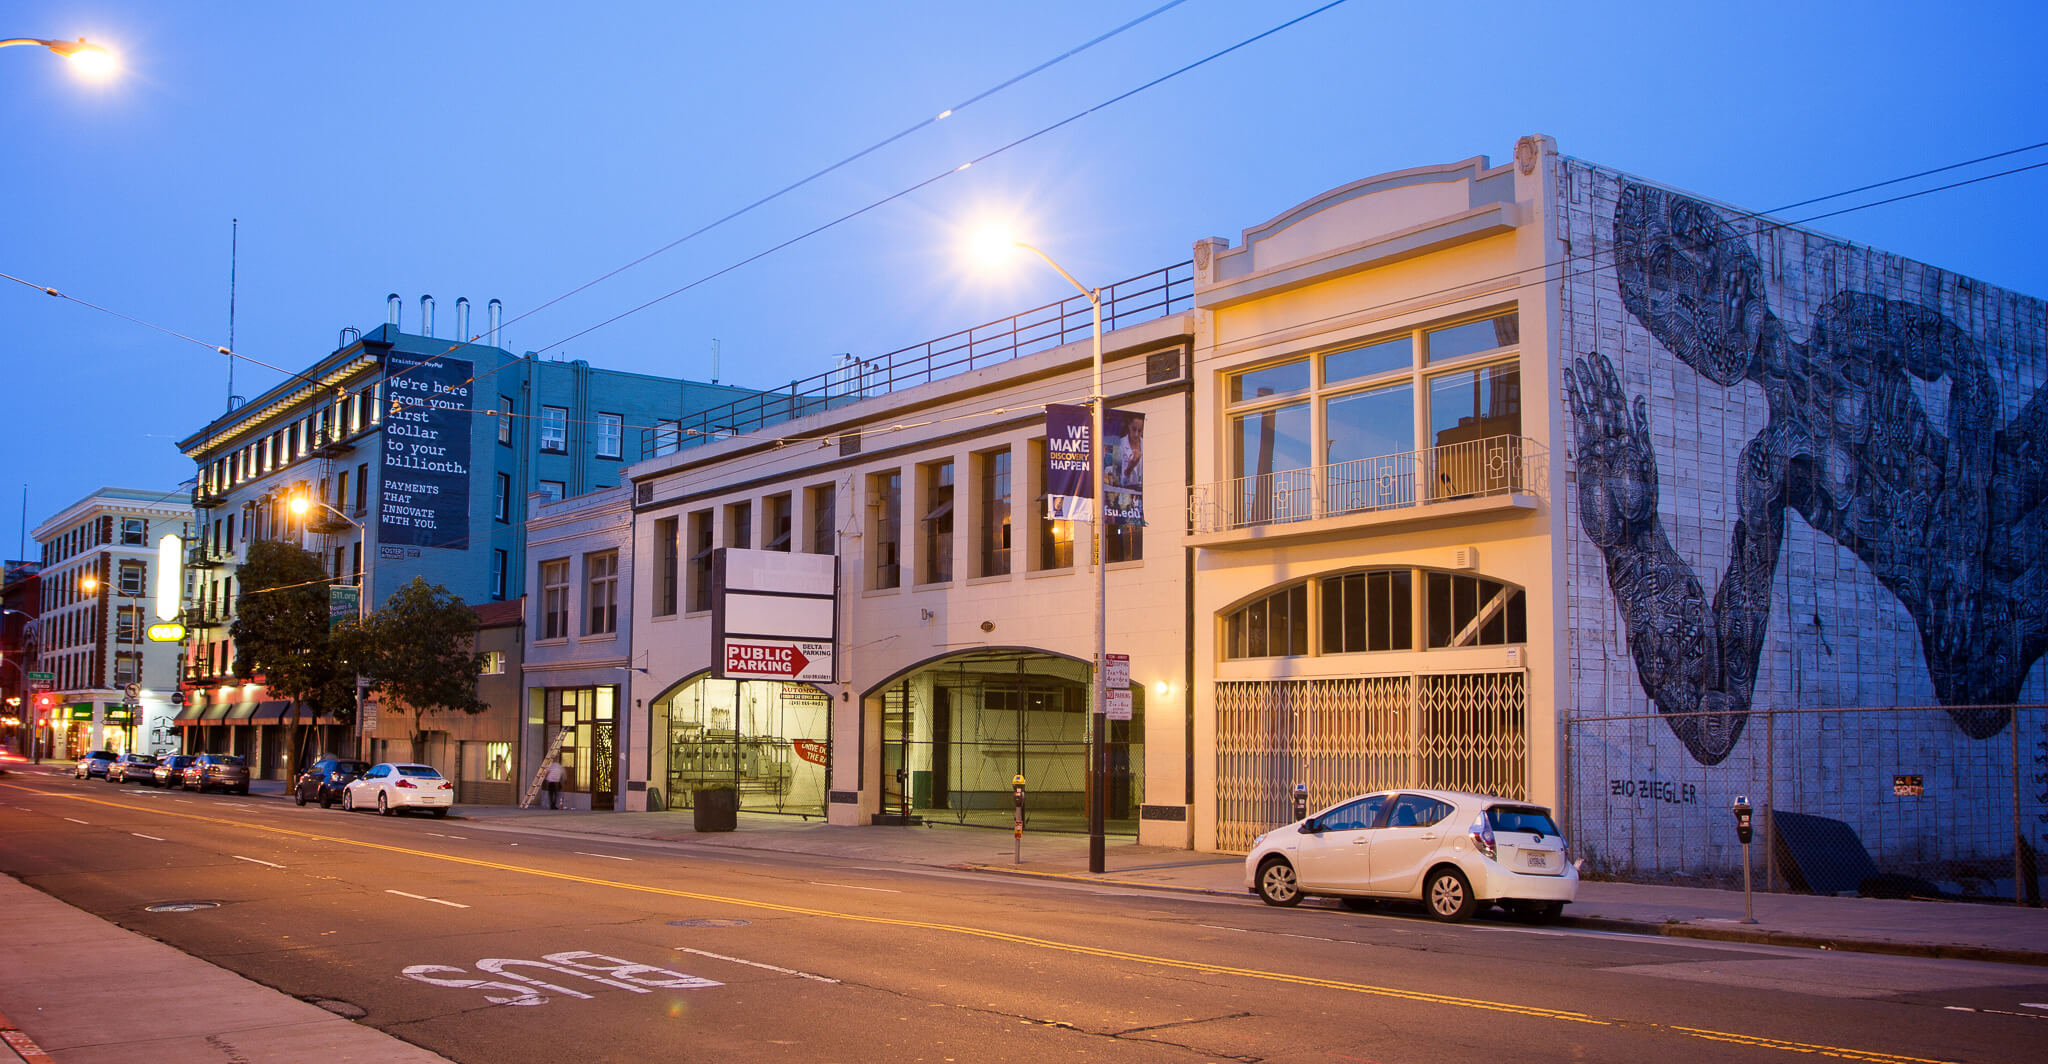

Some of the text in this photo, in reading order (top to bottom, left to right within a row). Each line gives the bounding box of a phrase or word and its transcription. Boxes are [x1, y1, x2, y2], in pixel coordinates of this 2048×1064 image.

[390, 376, 468, 397] We're here
[390, 391, 465, 411] from your
[388, 407, 430, 423] first
[387, 423, 439, 439] dollar
[1067, 425, 1090, 439] WE
[387, 439, 447, 456] to your
[1050, 438, 1090, 452] MAKE
[385, 453, 467, 474] billionth.
[1050, 451, 1089, 461] DISCOVERY
[1051, 460, 1090, 471] HAPPEN
[384, 480, 439, 494] PAYMENTS
[383, 492, 412, 503] THAT
[382, 504, 435, 519] INNOVATE
[1103, 505, 1141, 518] fsu.edu
[382, 514, 437, 529] WITH YOU.
[332, 591, 356, 602] 511.org
[728, 646, 793, 661] PUBLIC
[728, 659, 793, 673] PARKING
[1638, 780, 1697, 805] ZIEGLER
[401, 951, 726, 1006] BUS
